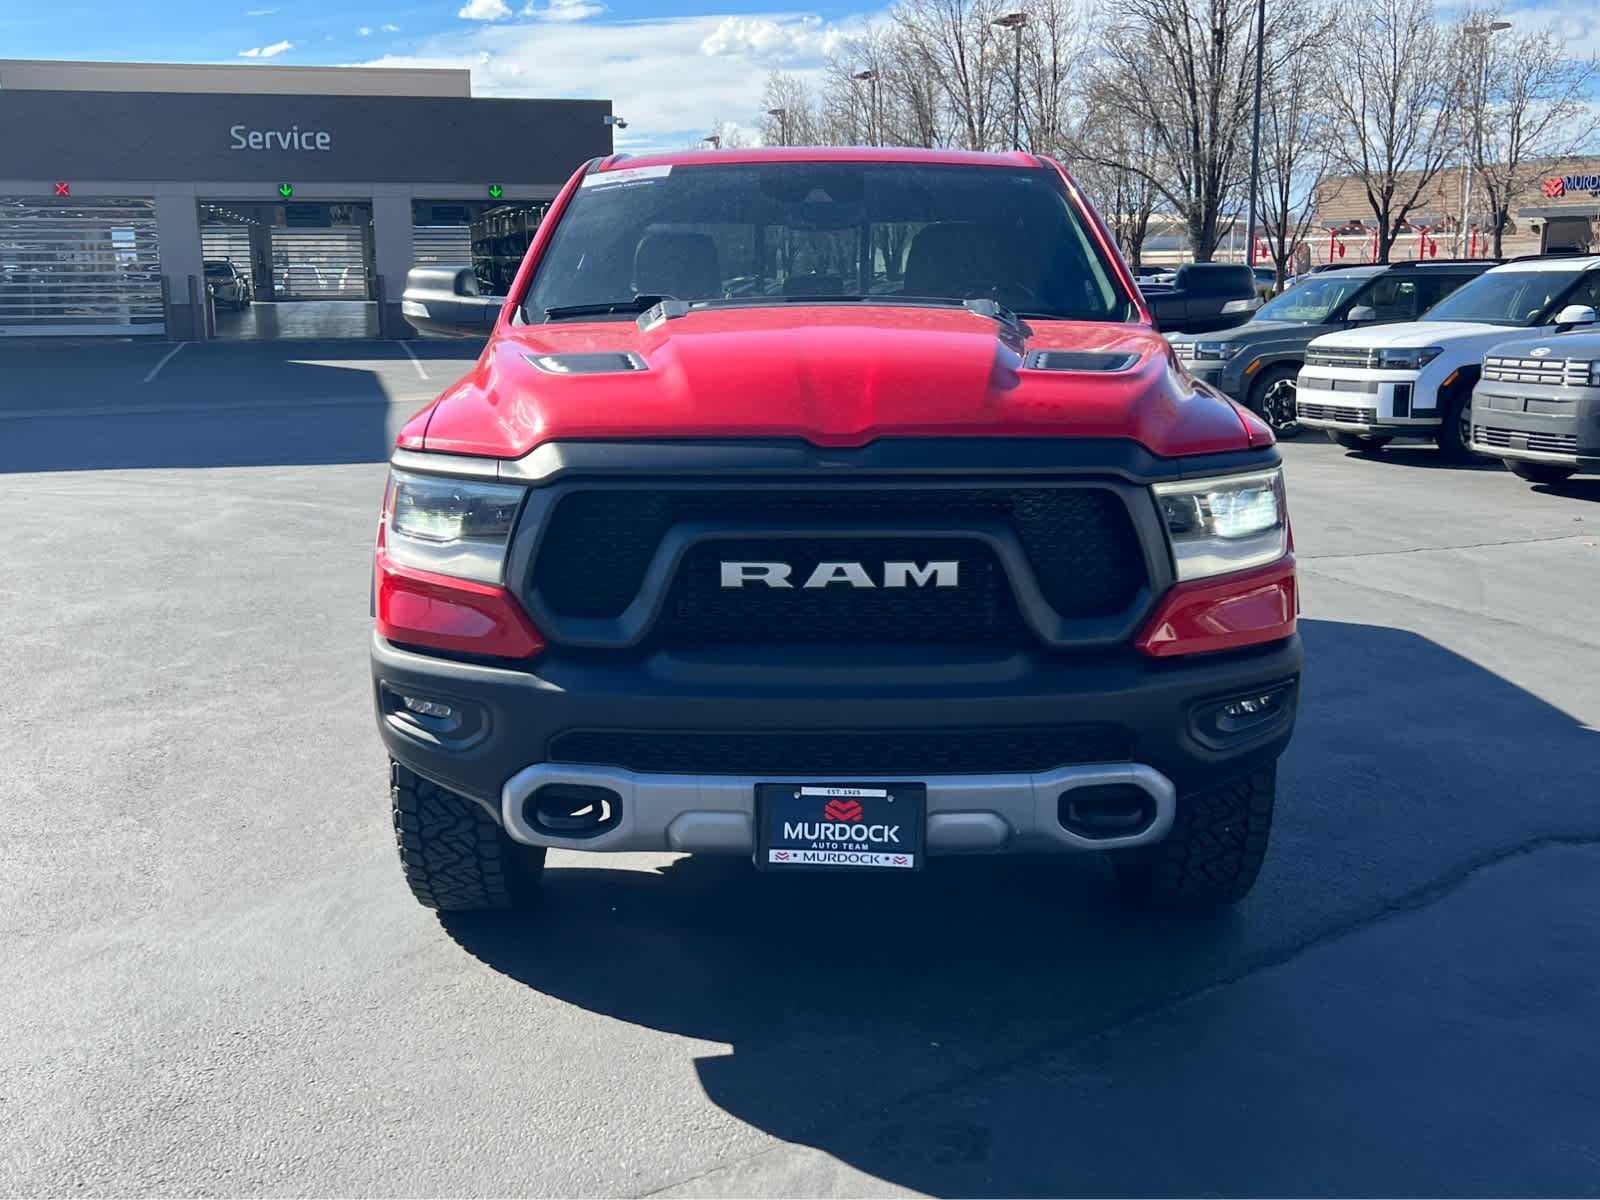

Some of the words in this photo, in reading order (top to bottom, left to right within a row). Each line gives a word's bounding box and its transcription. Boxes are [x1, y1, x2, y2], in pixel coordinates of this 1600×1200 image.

[230, 125, 331, 150] Service
[1565, 175, 1600, 191] MURD
[720, 561, 959, 588] RAM
[784, 822, 900, 843] MURDOCK
[803, 852, 880, 864] MURDOCK
